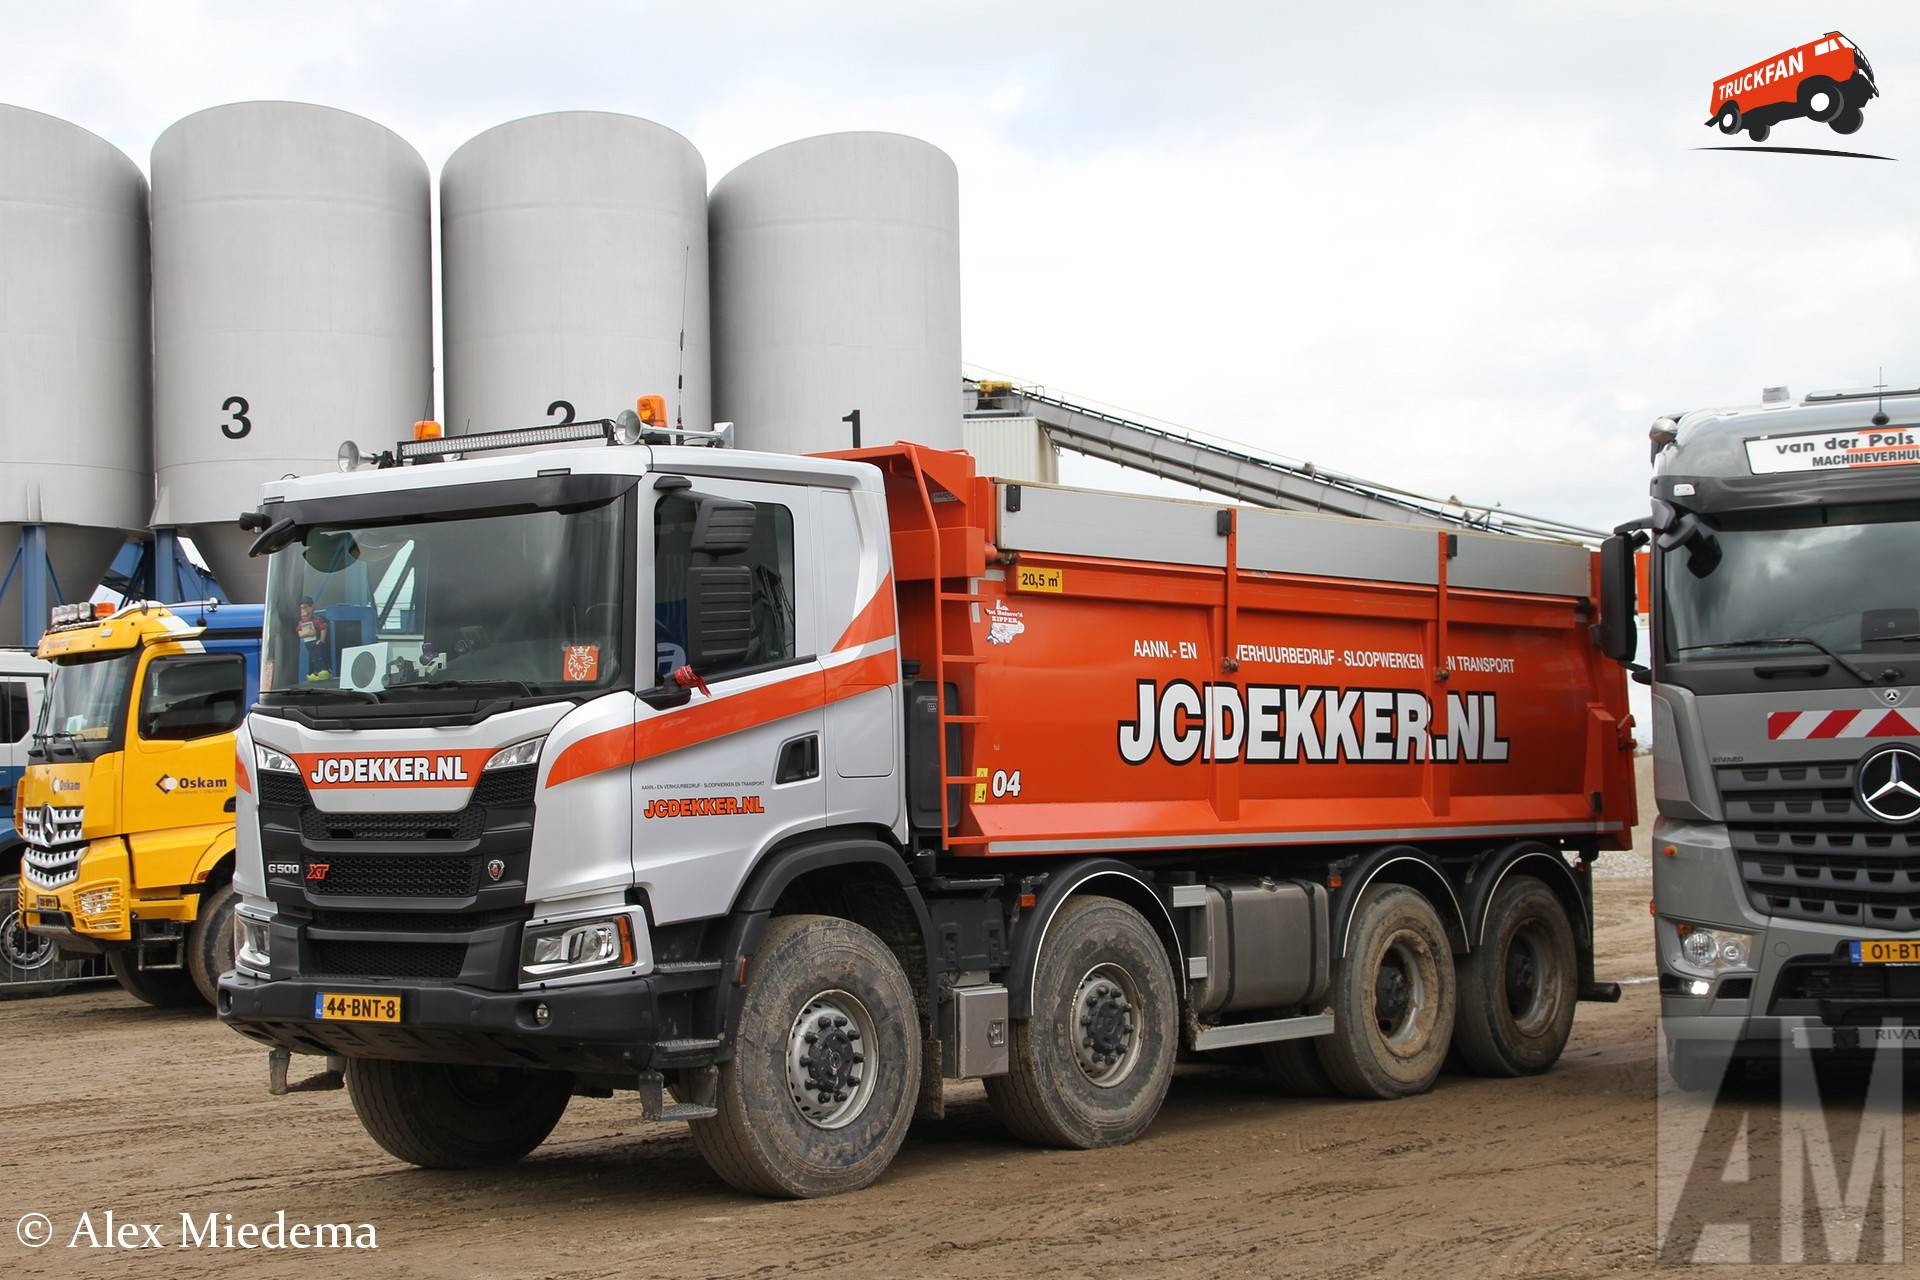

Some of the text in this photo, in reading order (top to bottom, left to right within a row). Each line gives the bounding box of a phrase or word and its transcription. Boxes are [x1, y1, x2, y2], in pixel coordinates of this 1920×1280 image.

[221, 396, 252, 440] 3
[842, 409, 861, 449] 1
[1776, 432, 1914, 455] van der Pols
[1022, 573, 1045, 589] 20,5
[1179, 641, 1198, 659] EN
[1343, 650, 1425, 670] SLOOPWERKEN
[1446, 655, 1456, 671] N
[1457, 656, 1515, 673] TRANSPORT
[1117, 677, 1511, 767] JCDEKKER.NL
[311, 755, 468, 784] JCDEKKER.NL
[180, 777, 228, 789] Oskam
[992, 769, 1022, 798] 04
[643, 796, 765, 819] JCDEKKER.NL
[306, 864, 331, 880] XT
[326, 997, 396, 1019] 44-BNT-8
[1875, 1028, 1920, 1041] RIVA
